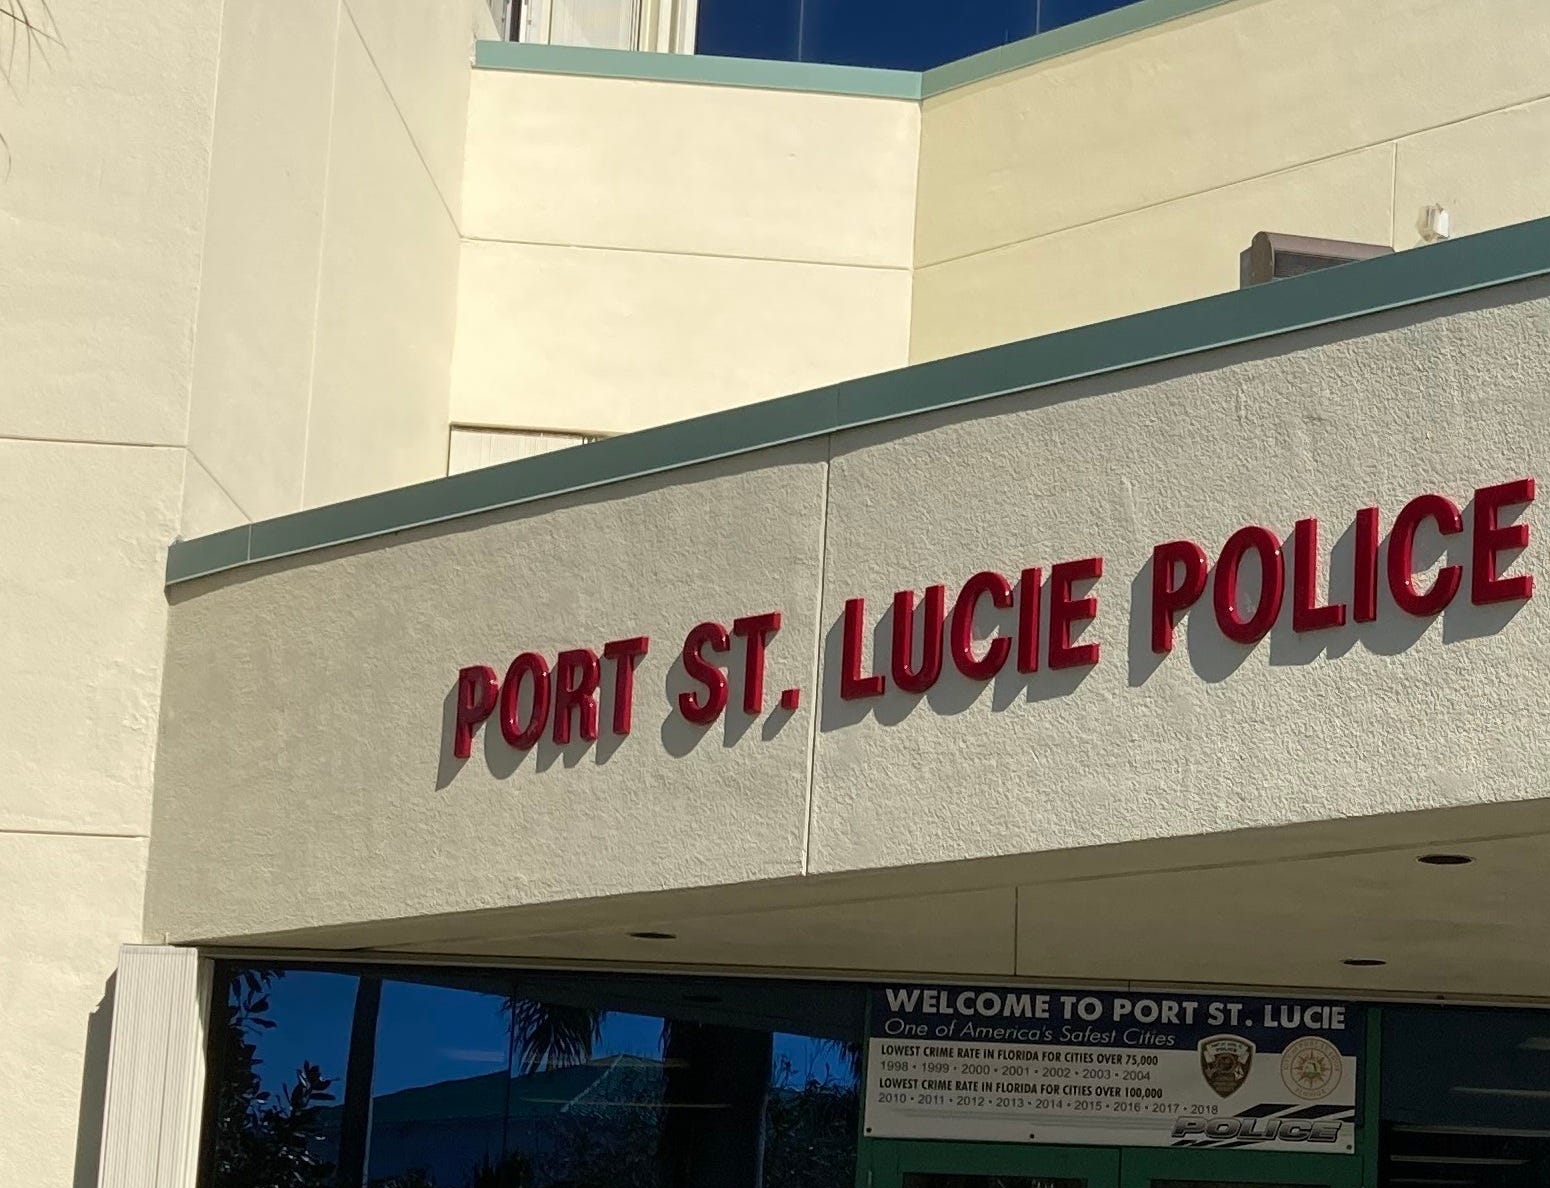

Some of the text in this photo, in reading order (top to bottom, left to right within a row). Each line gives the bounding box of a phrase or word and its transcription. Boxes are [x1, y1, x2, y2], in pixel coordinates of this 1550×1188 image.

[454, 636, 649, 758] PORT
[679, 612, 799, 724] ST.
[840, 557, 1102, 699] LUCIE
[1150, 478, 1535, 655] POLICE
[886, 988, 1346, 1030] WELCOME TO PORT ST. LUCIE
[885, 1018, 1175, 1046] One of America's Safest Cities
[881, 1045, 1159, 1067] LOWEST CRIME RATE IN FLORIDA FOR CITIES OVER 75,000
[881, 1061, 1151, 1081] 1998 1999 2000 2001 2002 2003 2004
[879, 1078, 1163, 1099] LOWEST CRIME RATE IN FLORIDA FOR CITIES OVER 100,000
[878, 1092, 1219, 1115] 2010 2011 2012 2013 2014 2015 2016 2017 2018
[1171, 1116, 1343, 1142] POLICE
